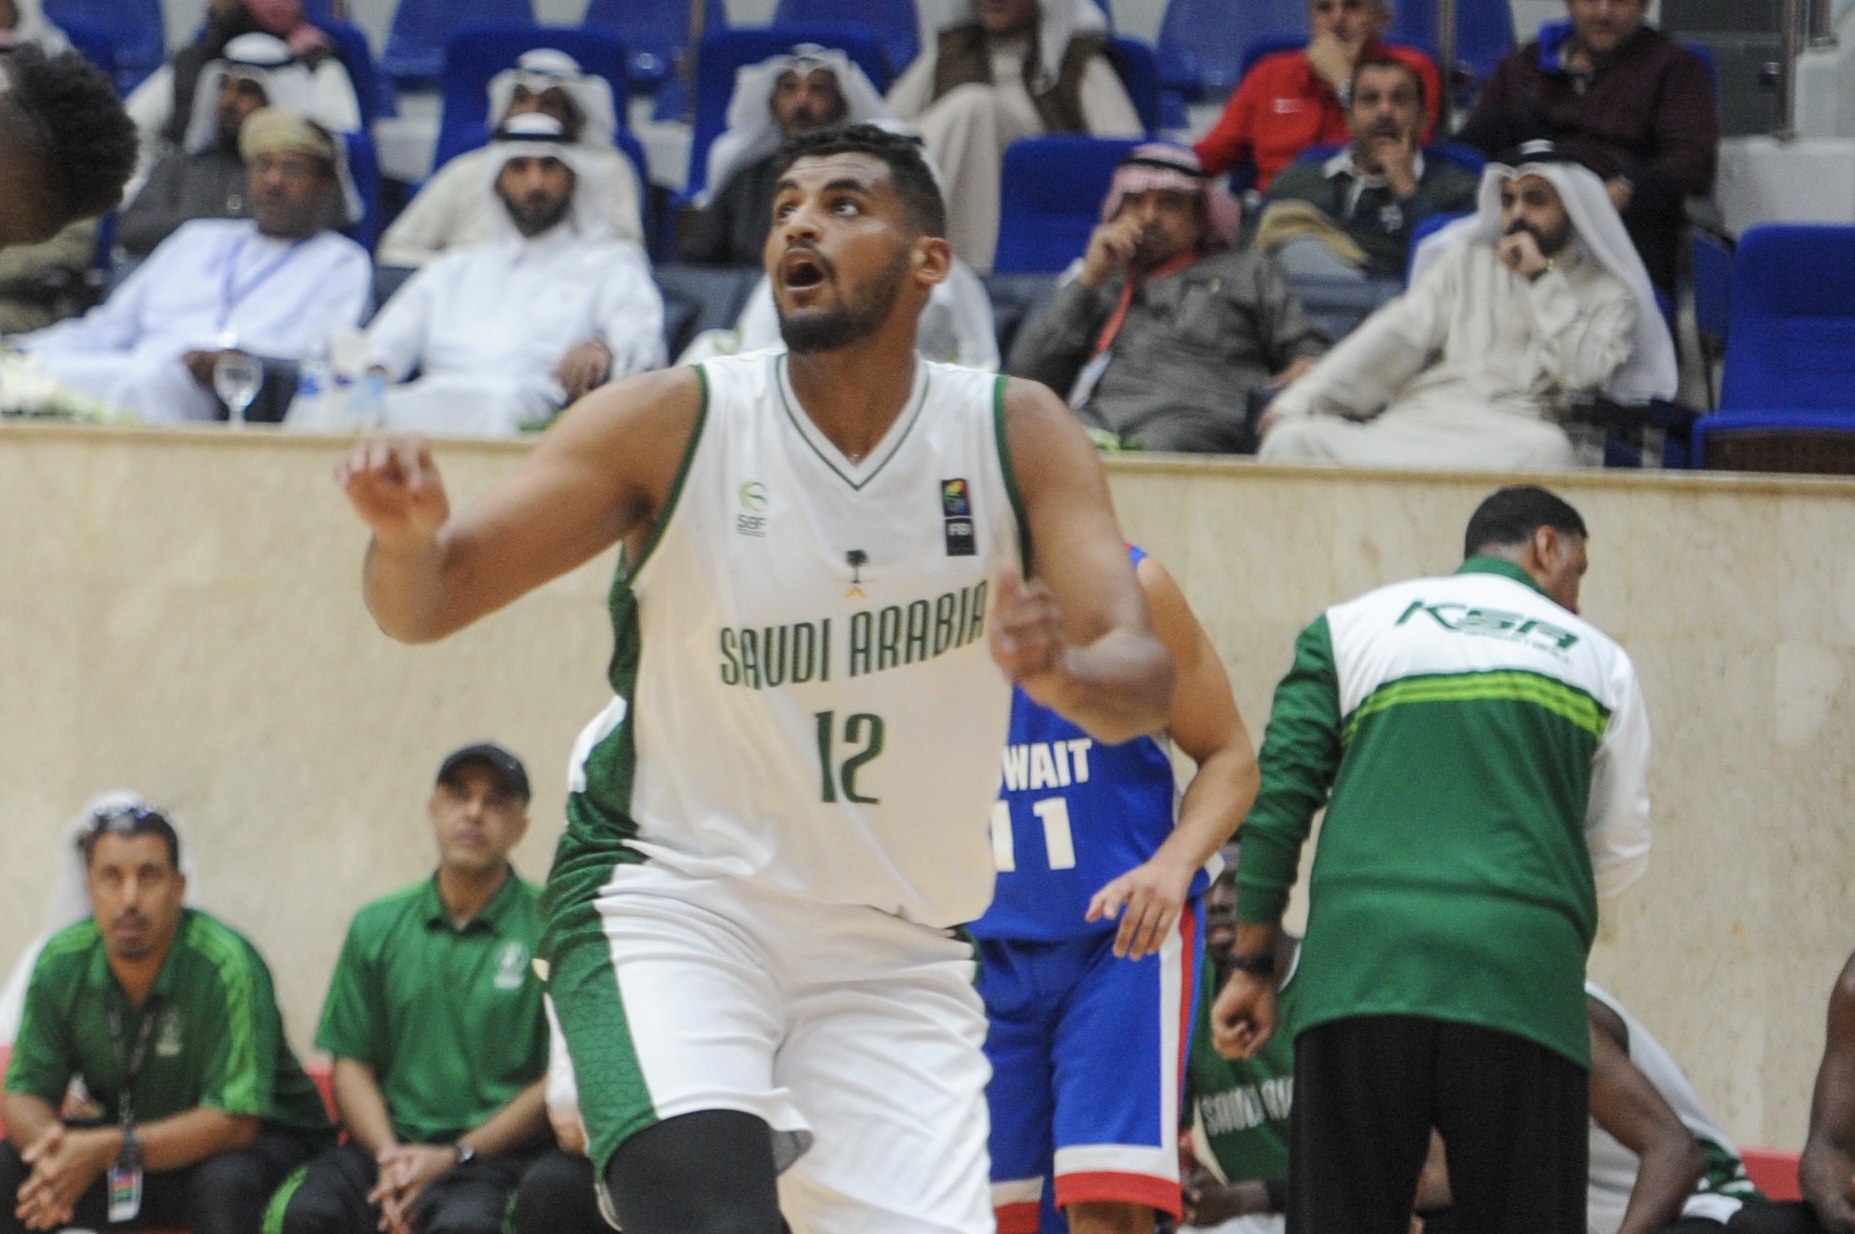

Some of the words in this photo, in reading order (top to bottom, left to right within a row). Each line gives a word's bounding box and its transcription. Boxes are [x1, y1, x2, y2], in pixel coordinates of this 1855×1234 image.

[720, 617, 832, 691] SAUDI
[848, 579, 989, 678] ARABIA
[814, 710, 886, 805] 12
